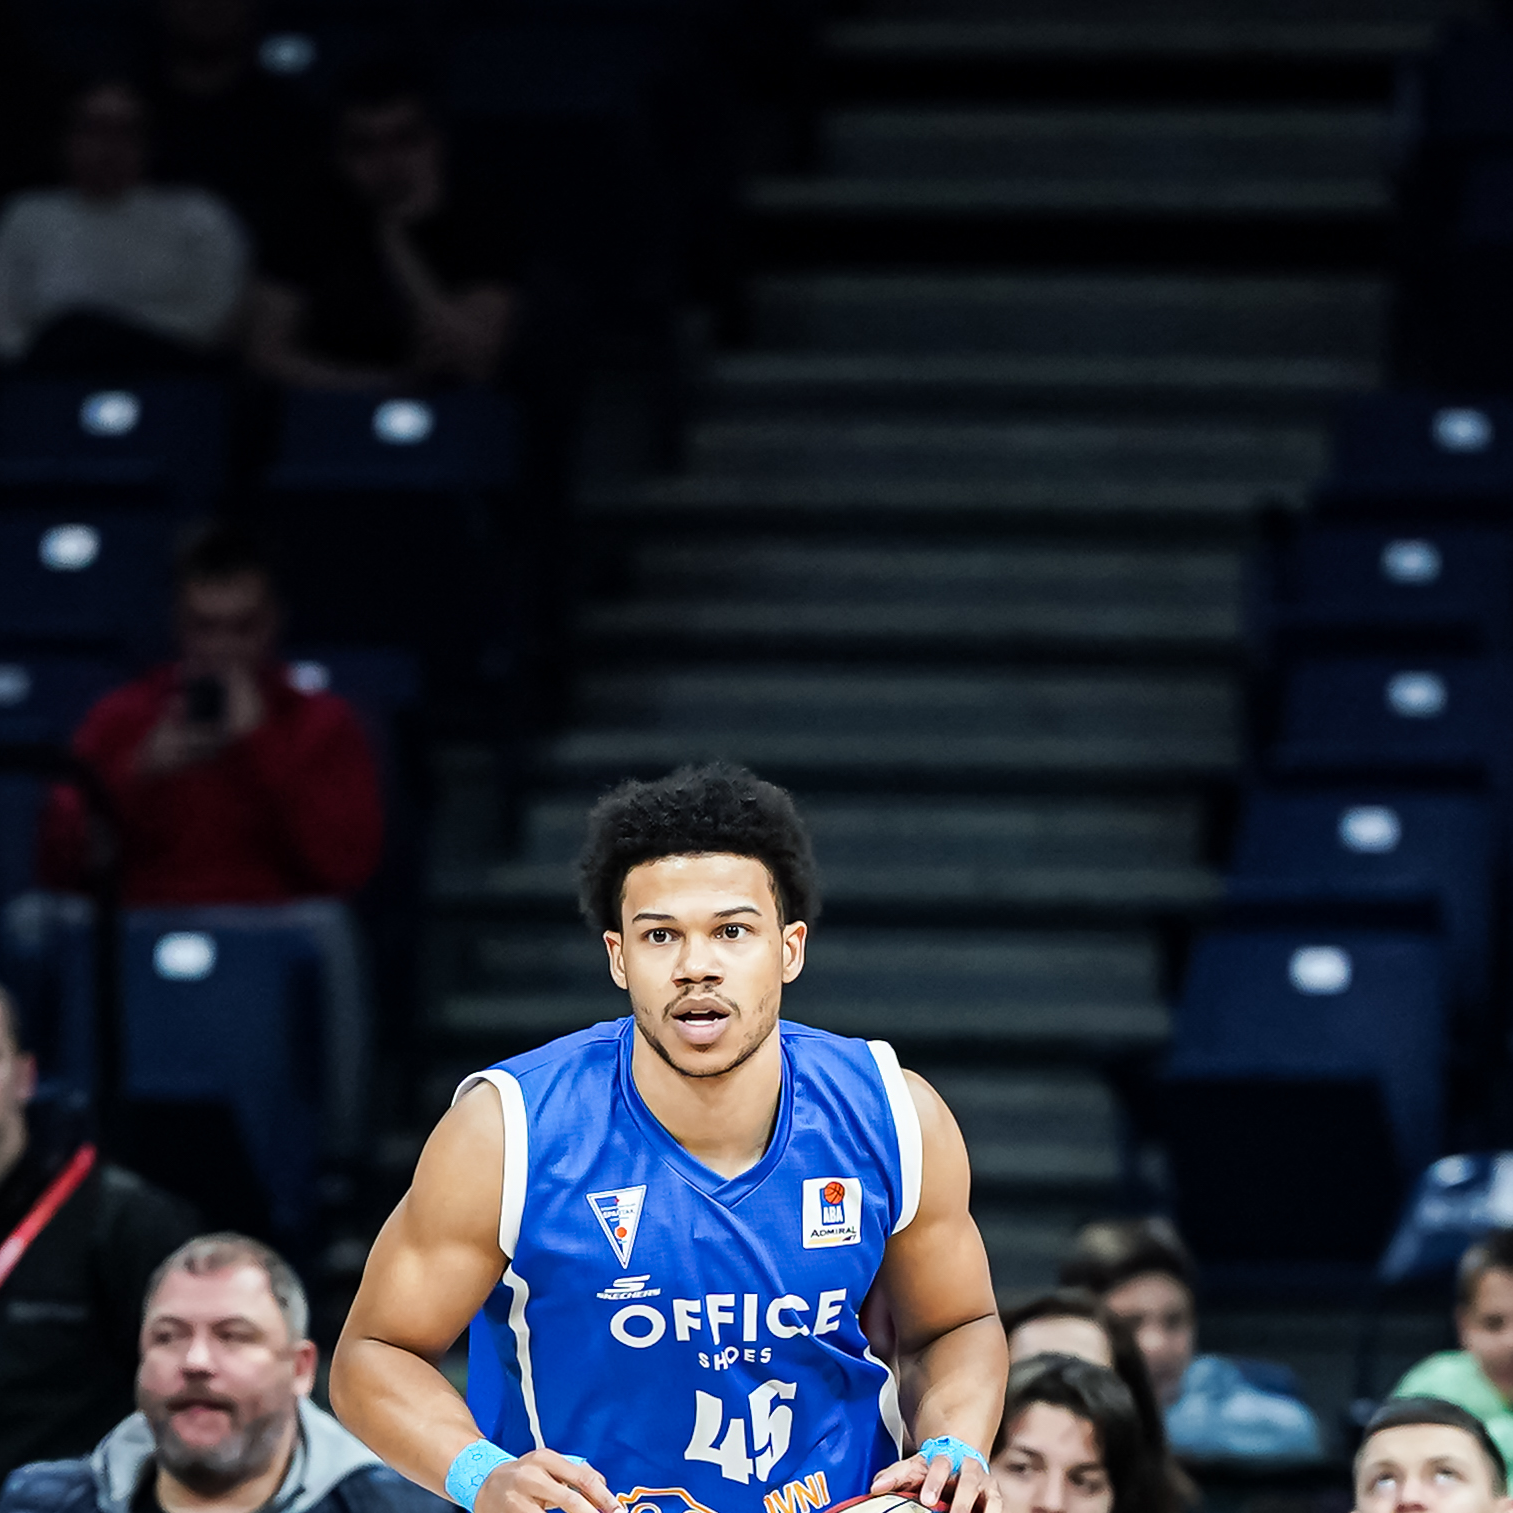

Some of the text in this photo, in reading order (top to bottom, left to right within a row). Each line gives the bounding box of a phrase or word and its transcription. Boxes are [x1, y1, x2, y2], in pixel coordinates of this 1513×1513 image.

[822, 1205, 844, 1225] ABA
[810, 1226, 858, 1239] ADMIRAL
[609, 1288, 848, 1349] OFFICE
[698, 1346, 773, 1371] SHOES
[684, 1379, 797, 1485] 45
